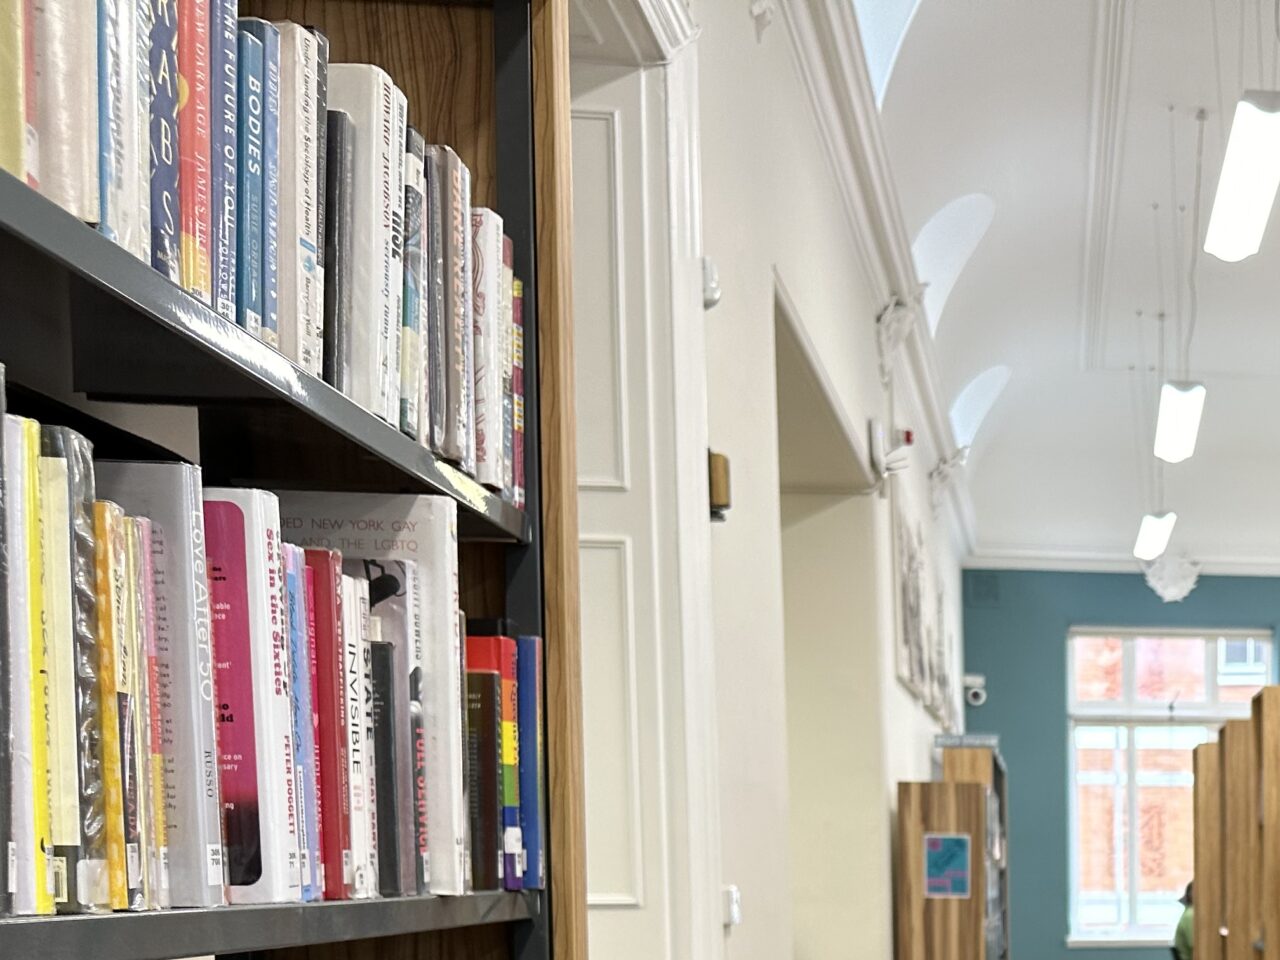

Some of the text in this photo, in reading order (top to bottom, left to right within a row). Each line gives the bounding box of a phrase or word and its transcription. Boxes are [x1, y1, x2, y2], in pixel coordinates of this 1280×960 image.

[224, 2, 236, 44] THE
[195, 45, 207, 93] DARK
[224, 50, 236, 135] FUTURE
[195, 103, 207, 140] AGE
[248, 75, 261, 176] BODIES
[303, 115, 313, 130] the
[224, 145, 236, 174] OF
[383, 153, 391, 229] JACOBSON
[304, 202, 313, 236] Health
[301, 537, 418, 551] AND THE LGBTQ
[311, 519, 418, 533] NEW YORK GAY
[192, 511, 212, 700] Love After 50
[266, 528, 282, 696] Sex in the Sixties
[348, 643, 361, 774] INVISIBLE
[363, 647, 375, 740] STATE
[204, 750, 213, 798] RUSSO
[284, 735, 296, 835] PETER DOGGETT
